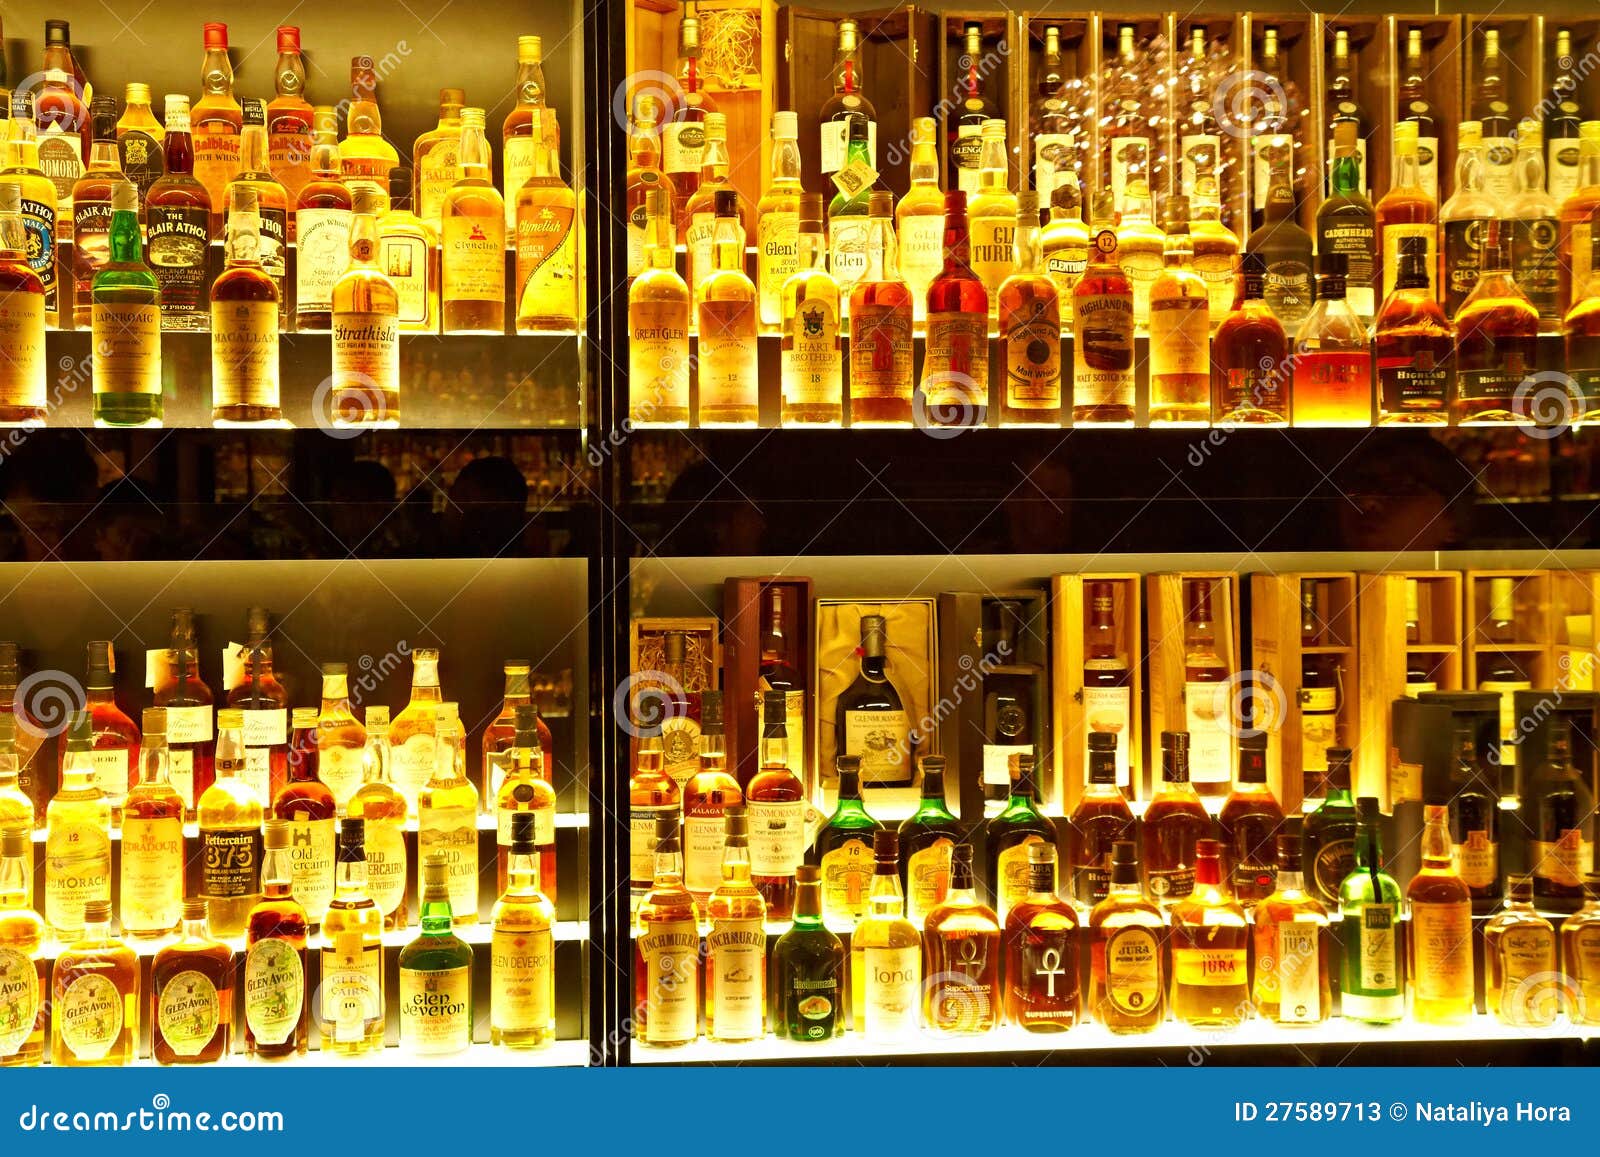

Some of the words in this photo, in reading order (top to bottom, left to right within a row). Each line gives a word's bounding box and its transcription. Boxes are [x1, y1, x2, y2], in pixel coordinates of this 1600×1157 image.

[21, 202, 54, 223] ATHOL
[75, 206, 100, 225] BLAIR
[167, 213, 183, 221] THE
[148, 222, 174, 238] BLAIR
[175, 222, 207, 241] ATHOL
[519, 219, 562, 233] Clynelish
[1102, 236, 1113, 248] 12
[765, 241, 792, 258] Glen
[770, 267, 787, 275] MALT
[1079, 299, 1121, 317] HIGHLAND
[94, 311, 154, 324] LAPHROAIG
[214, 333, 276, 344] MACALLAN
[634, 328, 662, 341] GREAT
[661, 327, 684, 341] GLEN
[799, 342, 830, 353] HART
[790, 352, 837, 363] BROTHERS
[727, 373, 738, 382] 12
[810, 374, 821, 384] 18
[1093, 373, 1121, 382] SCOTCH
[1397, 370, 1446, 380] HIGHLAND
[691, 807, 720, 816] MALAGA
[68, 832, 80, 842] 12
[204, 834, 253, 846] Fettercairn
[291, 847, 313, 860] Old
[849, 846, 860, 856] 16
[367, 852, 385, 863] OLD
[1118, 944, 1150, 956] JURA
[1284, 936, 1315, 955] JURA
[1202, 959, 1236, 977] JURA
[247, 977, 270, 992] GLEN
[270, 971, 295, 986] AVON
[332, 975, 368, 985] GLEN
[873, 966, 914, 985] Iona
[1, 980, 28, 995] AVON
[413, 992, 450, 1006] Glen
[1131, 995, 1140, 1005] 8
[66, 1005, 90, 1019] GLEN
[90, 1001, 112, 1013] AVON
[165, 1002, 188, 1015] GLEN
[188, 997, 210, 1010] AVON
[402, 1001, 465, 1017] deveron
